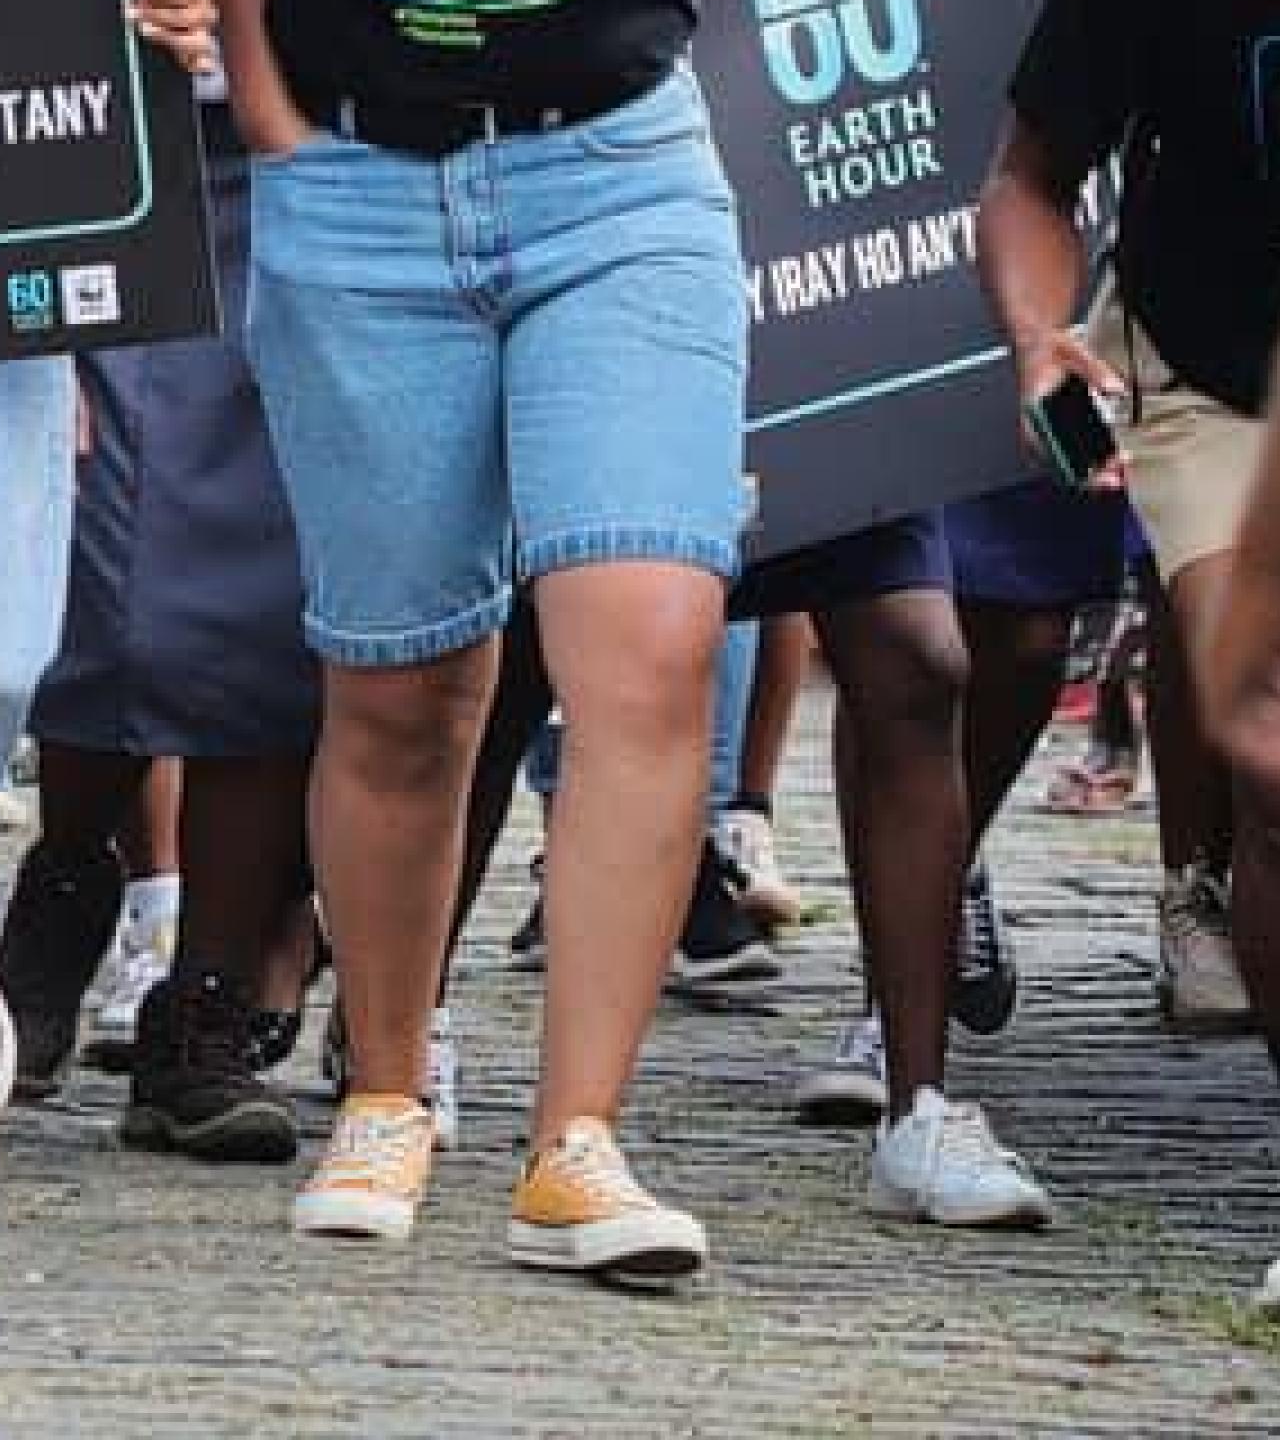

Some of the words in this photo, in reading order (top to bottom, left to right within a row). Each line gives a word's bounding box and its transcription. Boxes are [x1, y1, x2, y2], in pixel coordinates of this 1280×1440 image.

[788, 90, 937, 164] EARTH
[804, 139, 942, 207] HOUR
[768, 243, 848, 316] IRAY
[852, 229, 903, 289] HO
